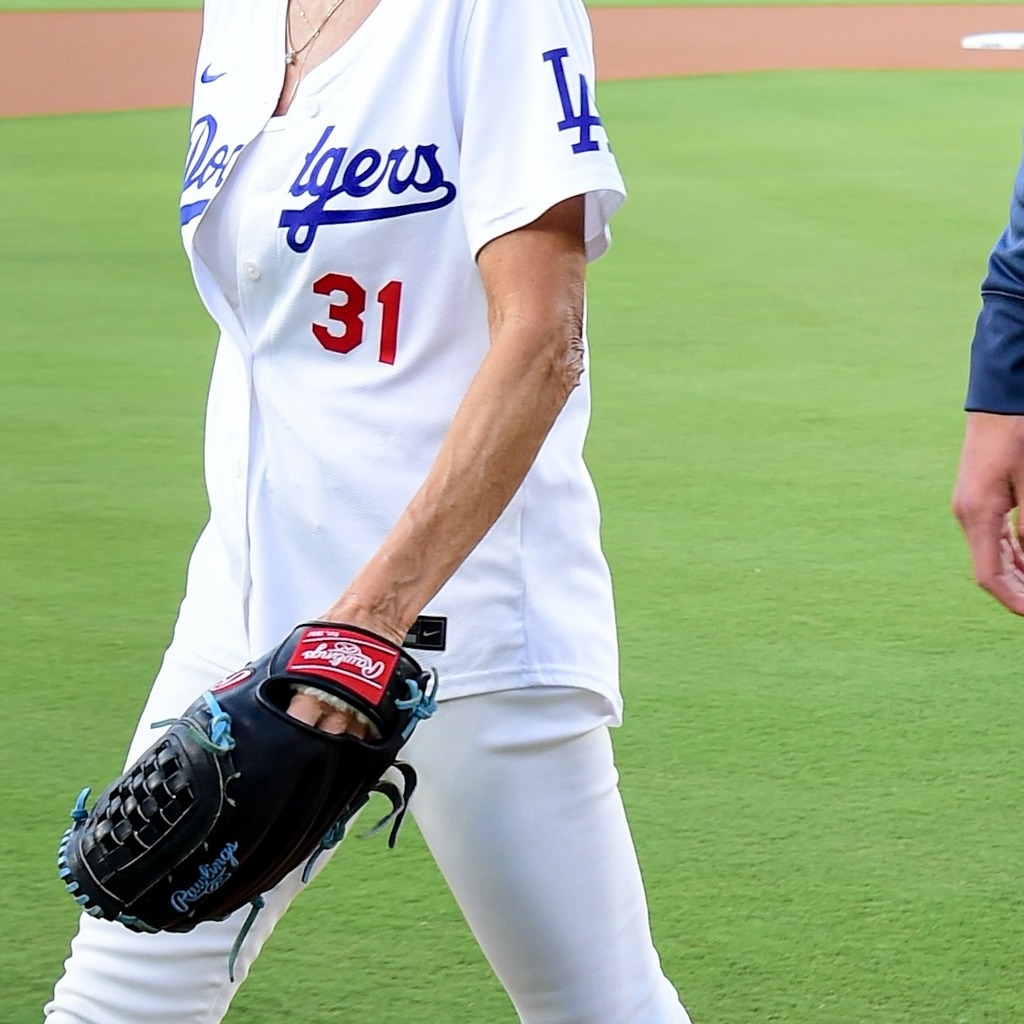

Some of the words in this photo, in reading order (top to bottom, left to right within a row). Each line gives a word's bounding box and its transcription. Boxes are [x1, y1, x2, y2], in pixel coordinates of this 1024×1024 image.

[312, 272, 403, 366] 31
[301, 642, 386, 680] Rawlings
[170, 840, 240, 913] Rawlings
